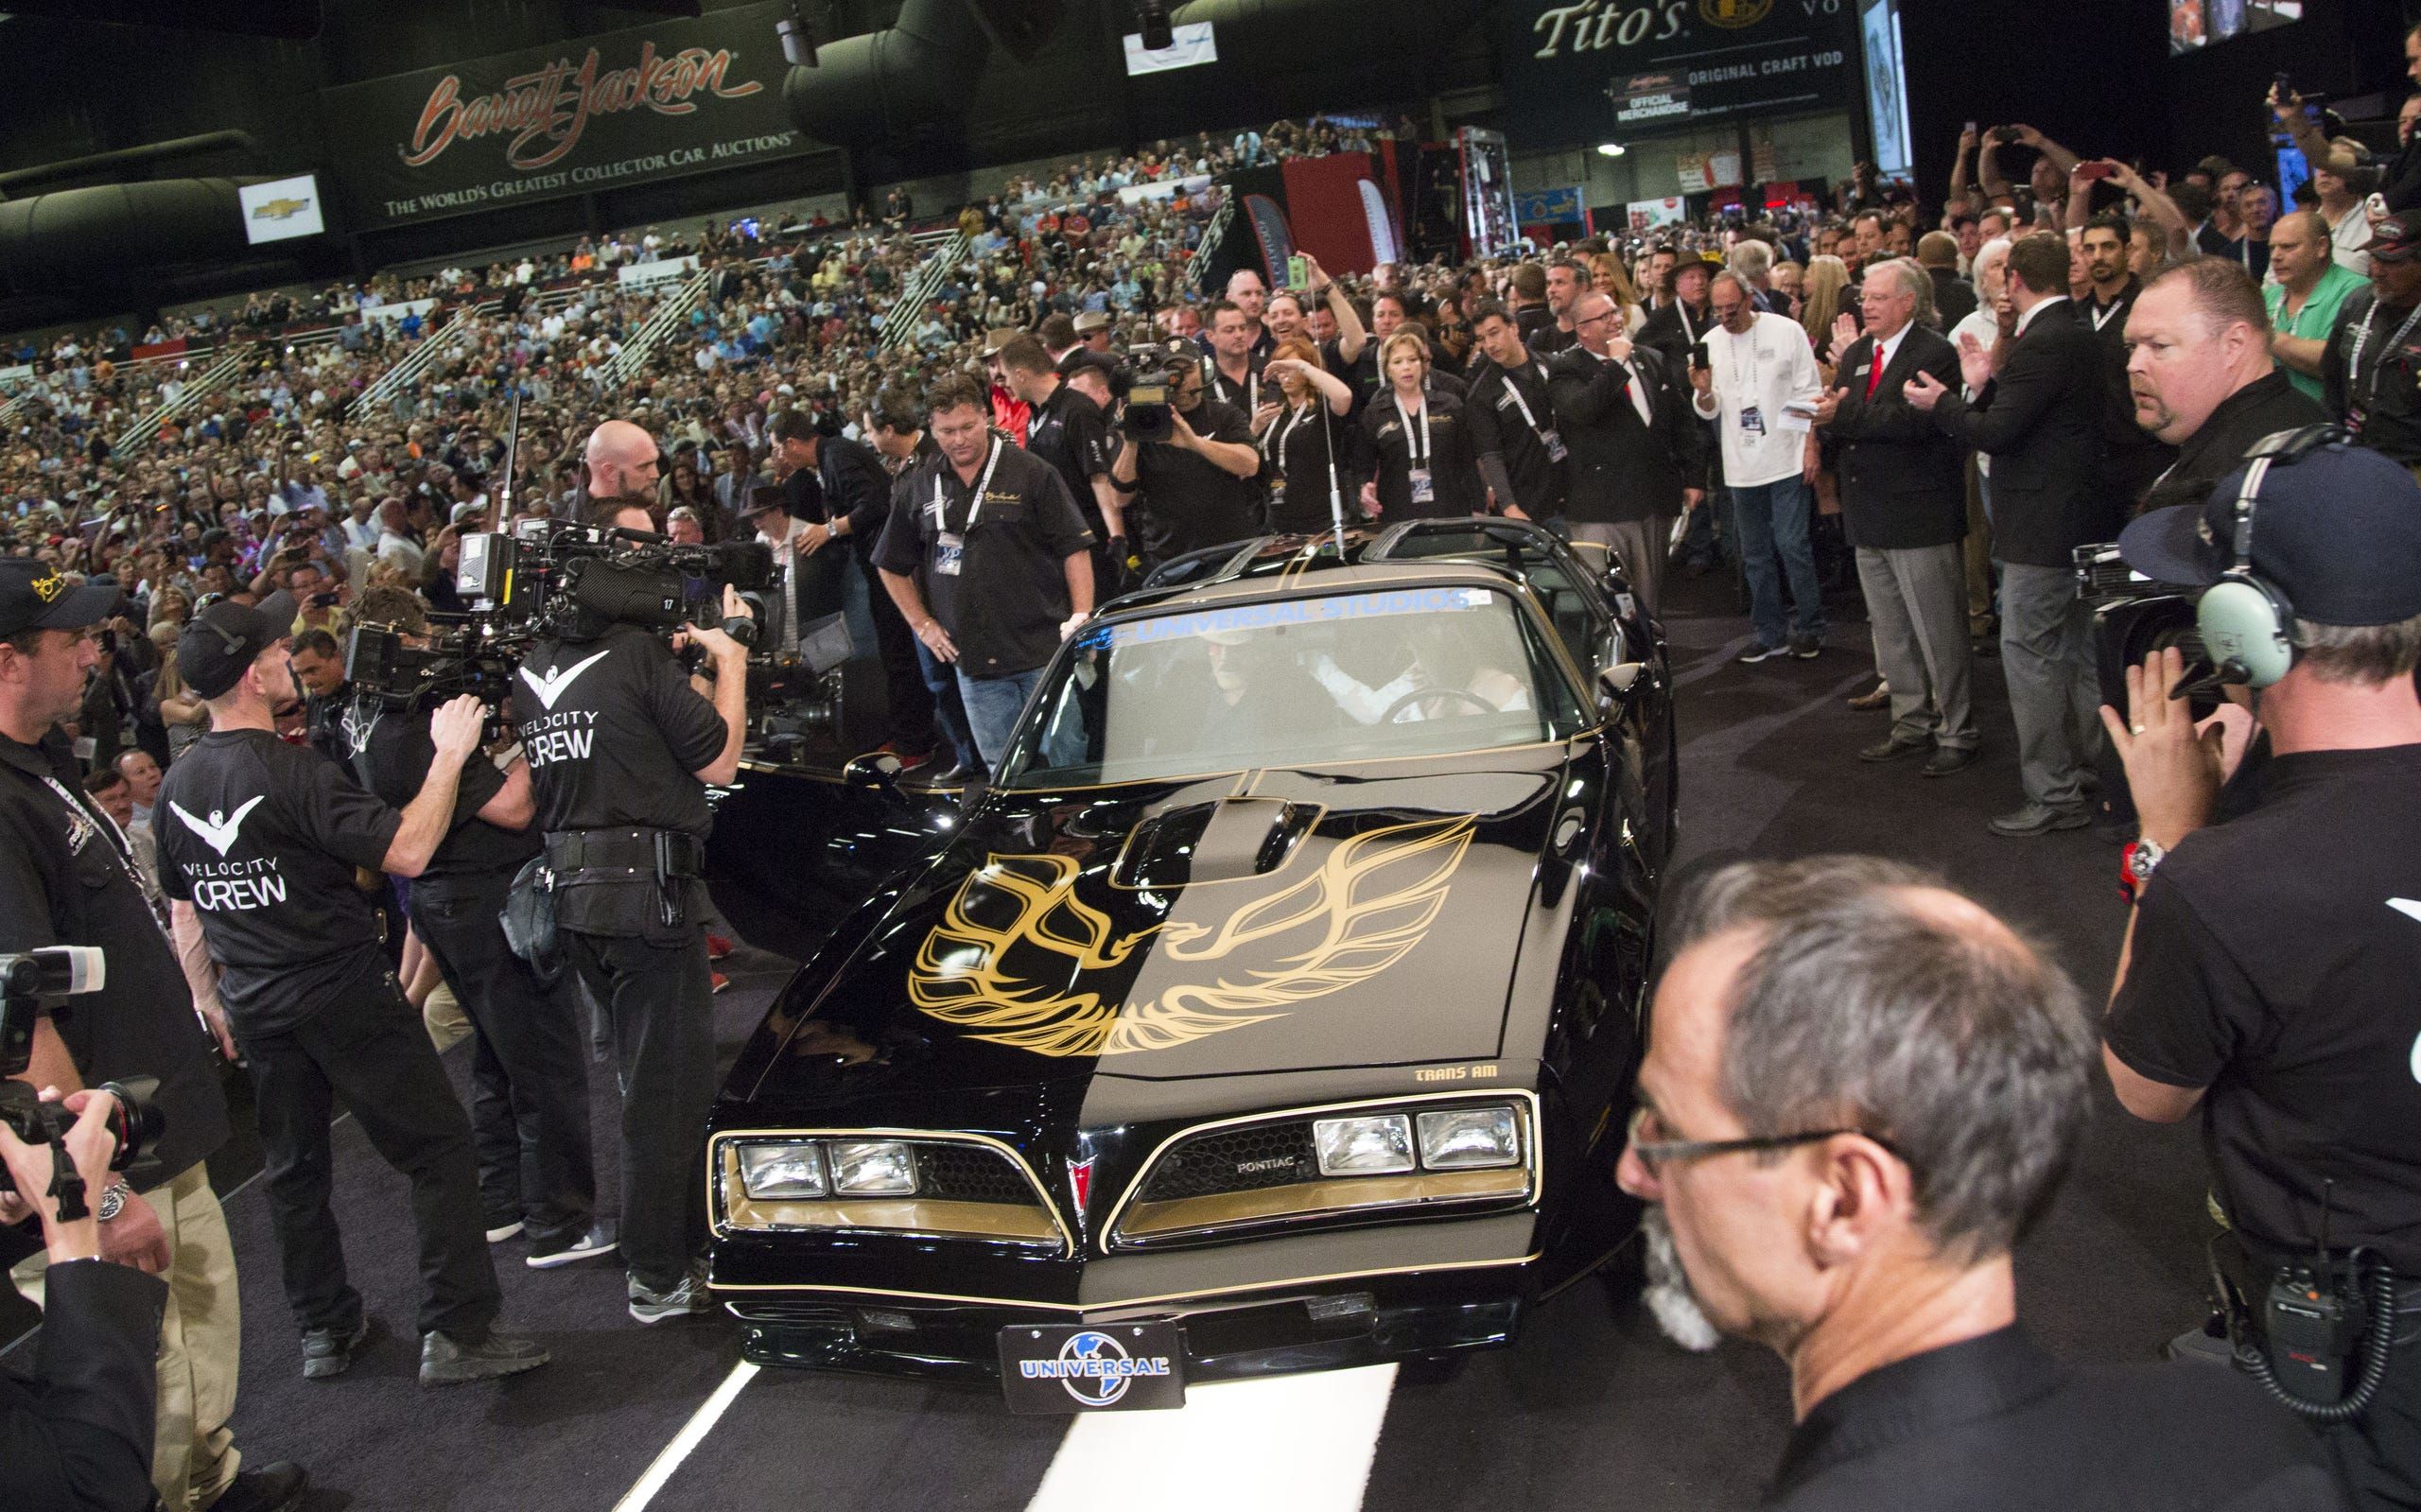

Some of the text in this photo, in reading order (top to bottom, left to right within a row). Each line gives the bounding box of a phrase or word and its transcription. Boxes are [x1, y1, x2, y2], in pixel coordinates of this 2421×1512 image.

[1688, 62, 1756, 86] ORIGINAL
[1761, 54, 1807, 75] CRAFT
[1617, 101, 1688, 121] MERCHANDISE
[1629, 94, 1673, 109] OFFICIAL
[385, 130, 793, 217] THE WORLD'S GREATEST COLLECTOR CAR AUCTIONS
[664, 599, 674, 611] 17
[1136, 588, 1471, 641] UNIVERSAL STUDIOS
[517, 710, 600, 738] VELOCITY
[527, 728, 594, 769] CREW
[182, 856, 277, 878] VELOCITY
[194, 873, 287, 912] CREW
[1415, 1065, 1498, 1083] TRANS AM
[1238, 1156, 1295, 1174] PONTIAC
[1019, 1356, 1171, 1379] UNIVERSAL
